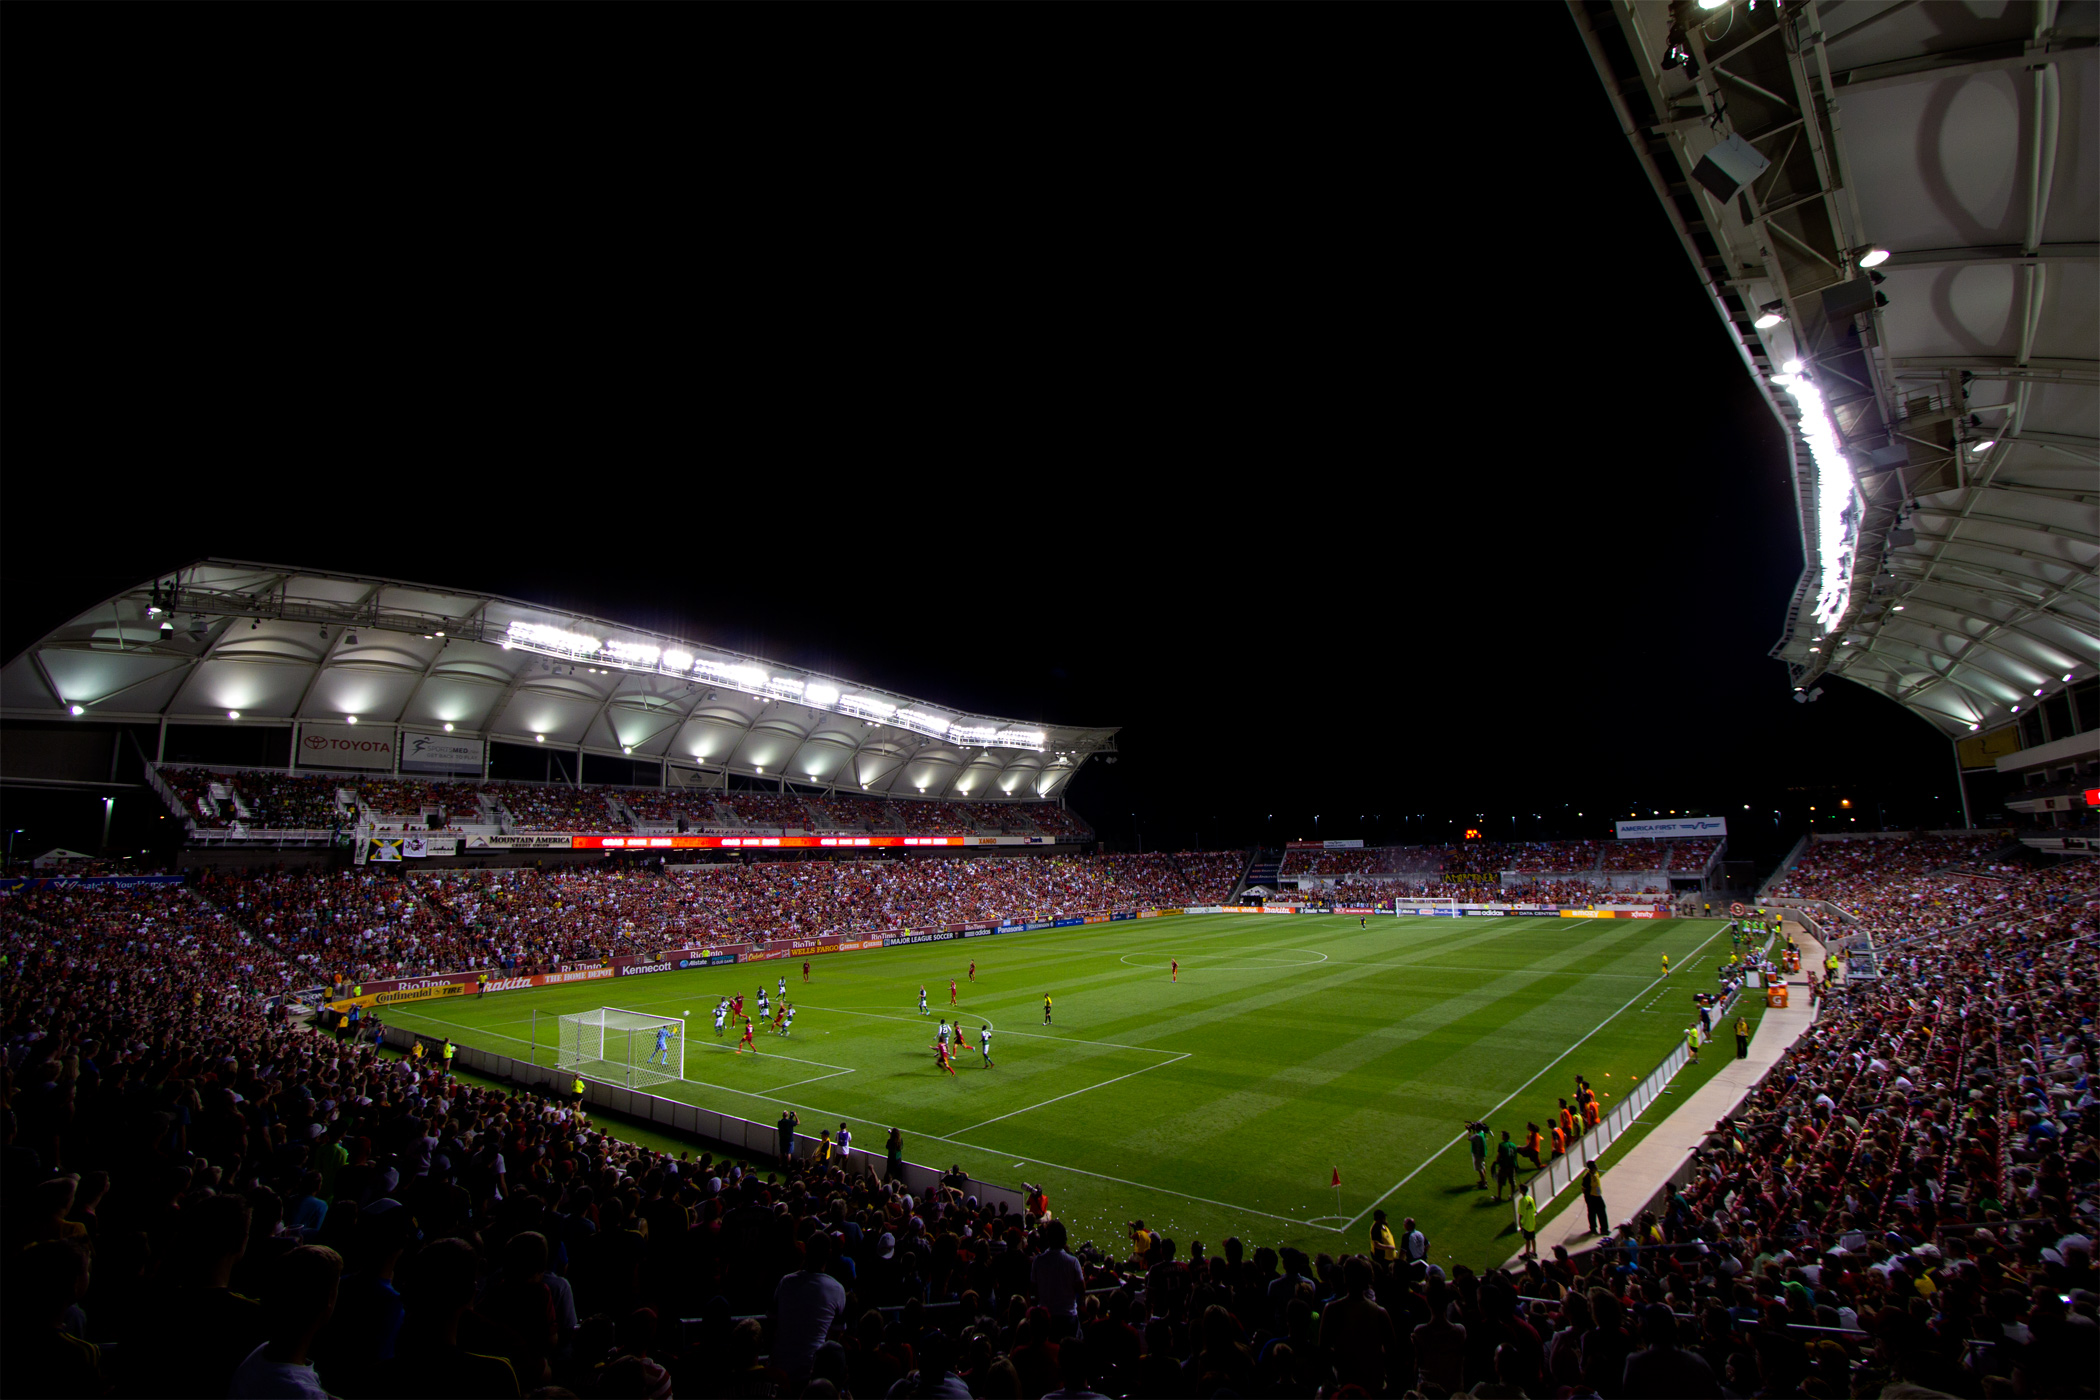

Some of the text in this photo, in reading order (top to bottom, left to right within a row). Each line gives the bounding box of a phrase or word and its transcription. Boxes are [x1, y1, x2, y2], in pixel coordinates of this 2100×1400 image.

[330, 739, 391, 753] TOYOTA
[489, 836, 571, 844] MOUNTAIN AMERICA
[1630, 911, 1654, 919] xfinity
[975, 928, 991, 936] adidas
[997, 925, 1024, 934] Panasonic
[890, 932, 954, 946] MAJOR LEAGUE SOCCER
[791, 947, 816, 956] WELLS
[816, 944, 839, 953] FARGO
[622, 961, 672, 976] Kennecott
[688, 959, 708, 967] Allstate
[544, 967, 613, 984] THE HOME DEPOT
[483, 976, 533, 993] makita
[376, 986, 464, 1004] Continental TIRE
[1772, 995, 1782, 1004] G
